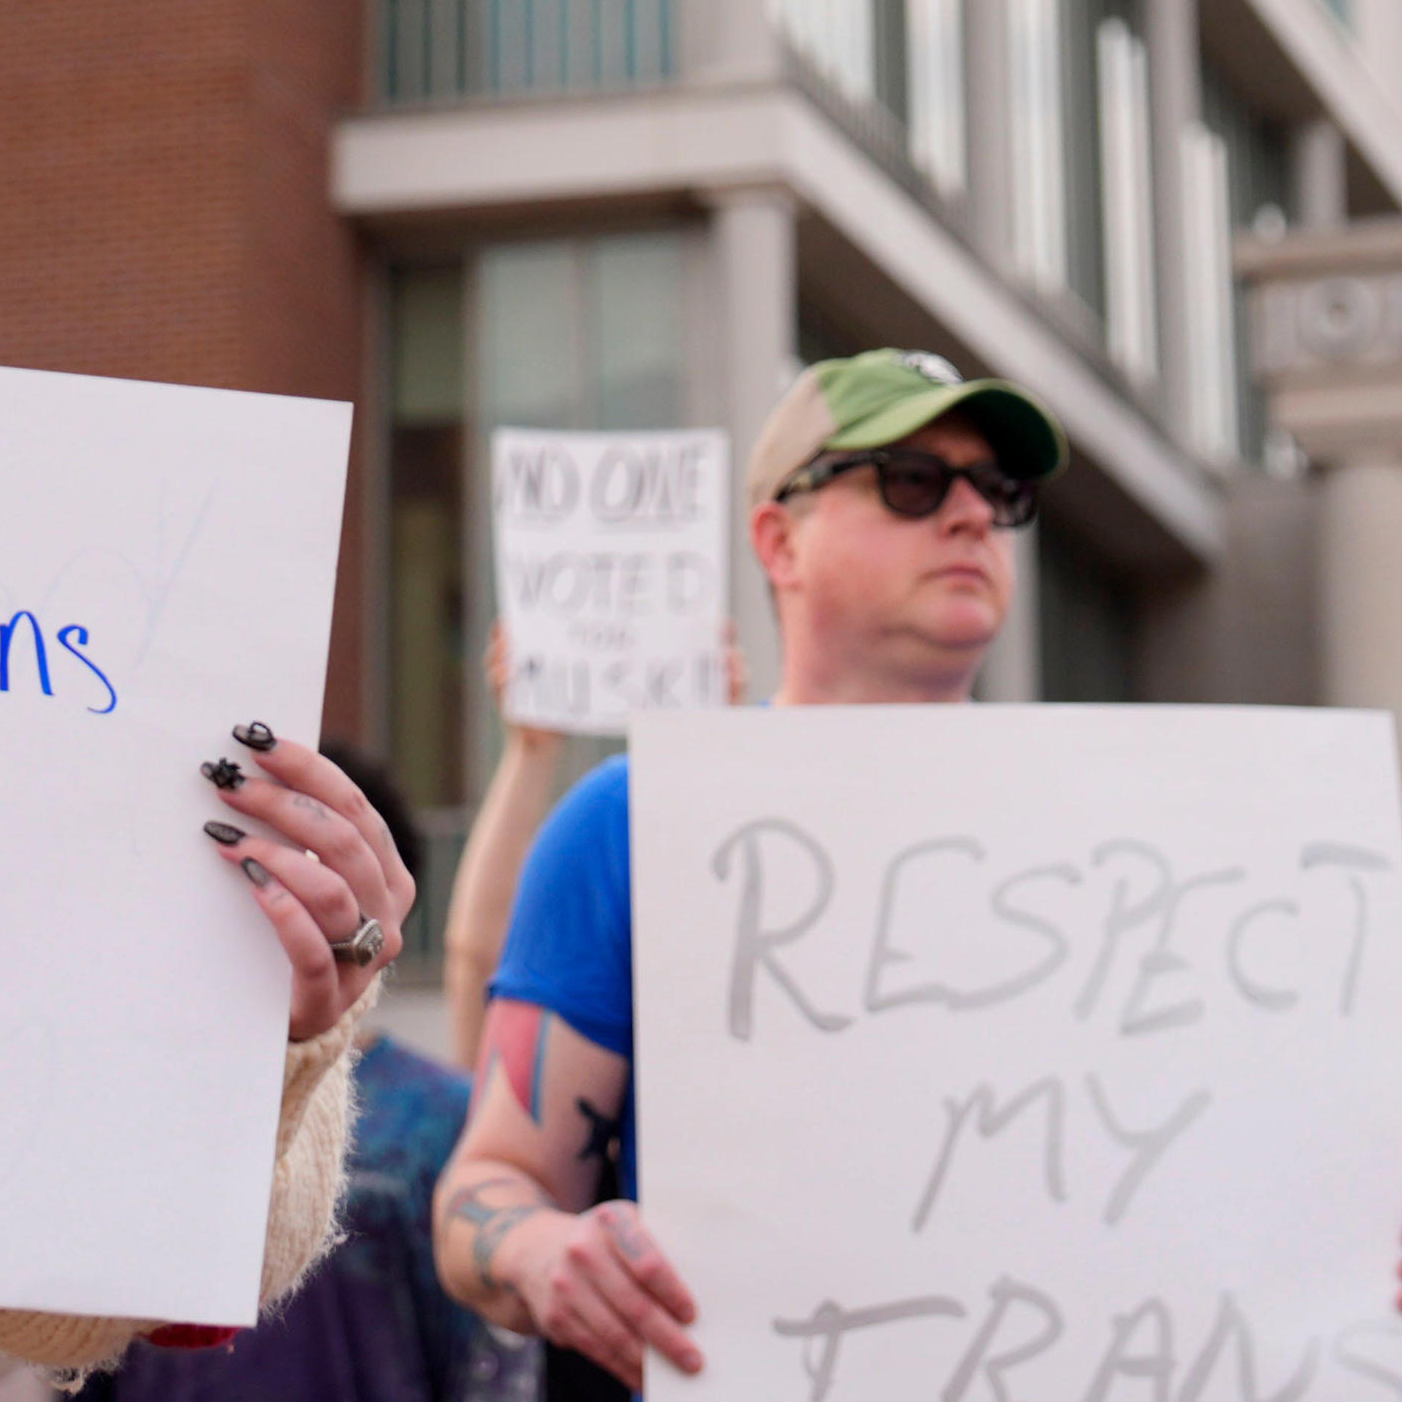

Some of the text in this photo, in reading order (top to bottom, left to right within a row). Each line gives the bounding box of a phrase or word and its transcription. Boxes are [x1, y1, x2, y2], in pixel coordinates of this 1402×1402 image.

[589, 443, 708, 530] ONE
[506, 550, 714, 618] VOTED
[713, 817, 1393, 1042] RESPECT
[911, 1071, 1212, 1234] MY
